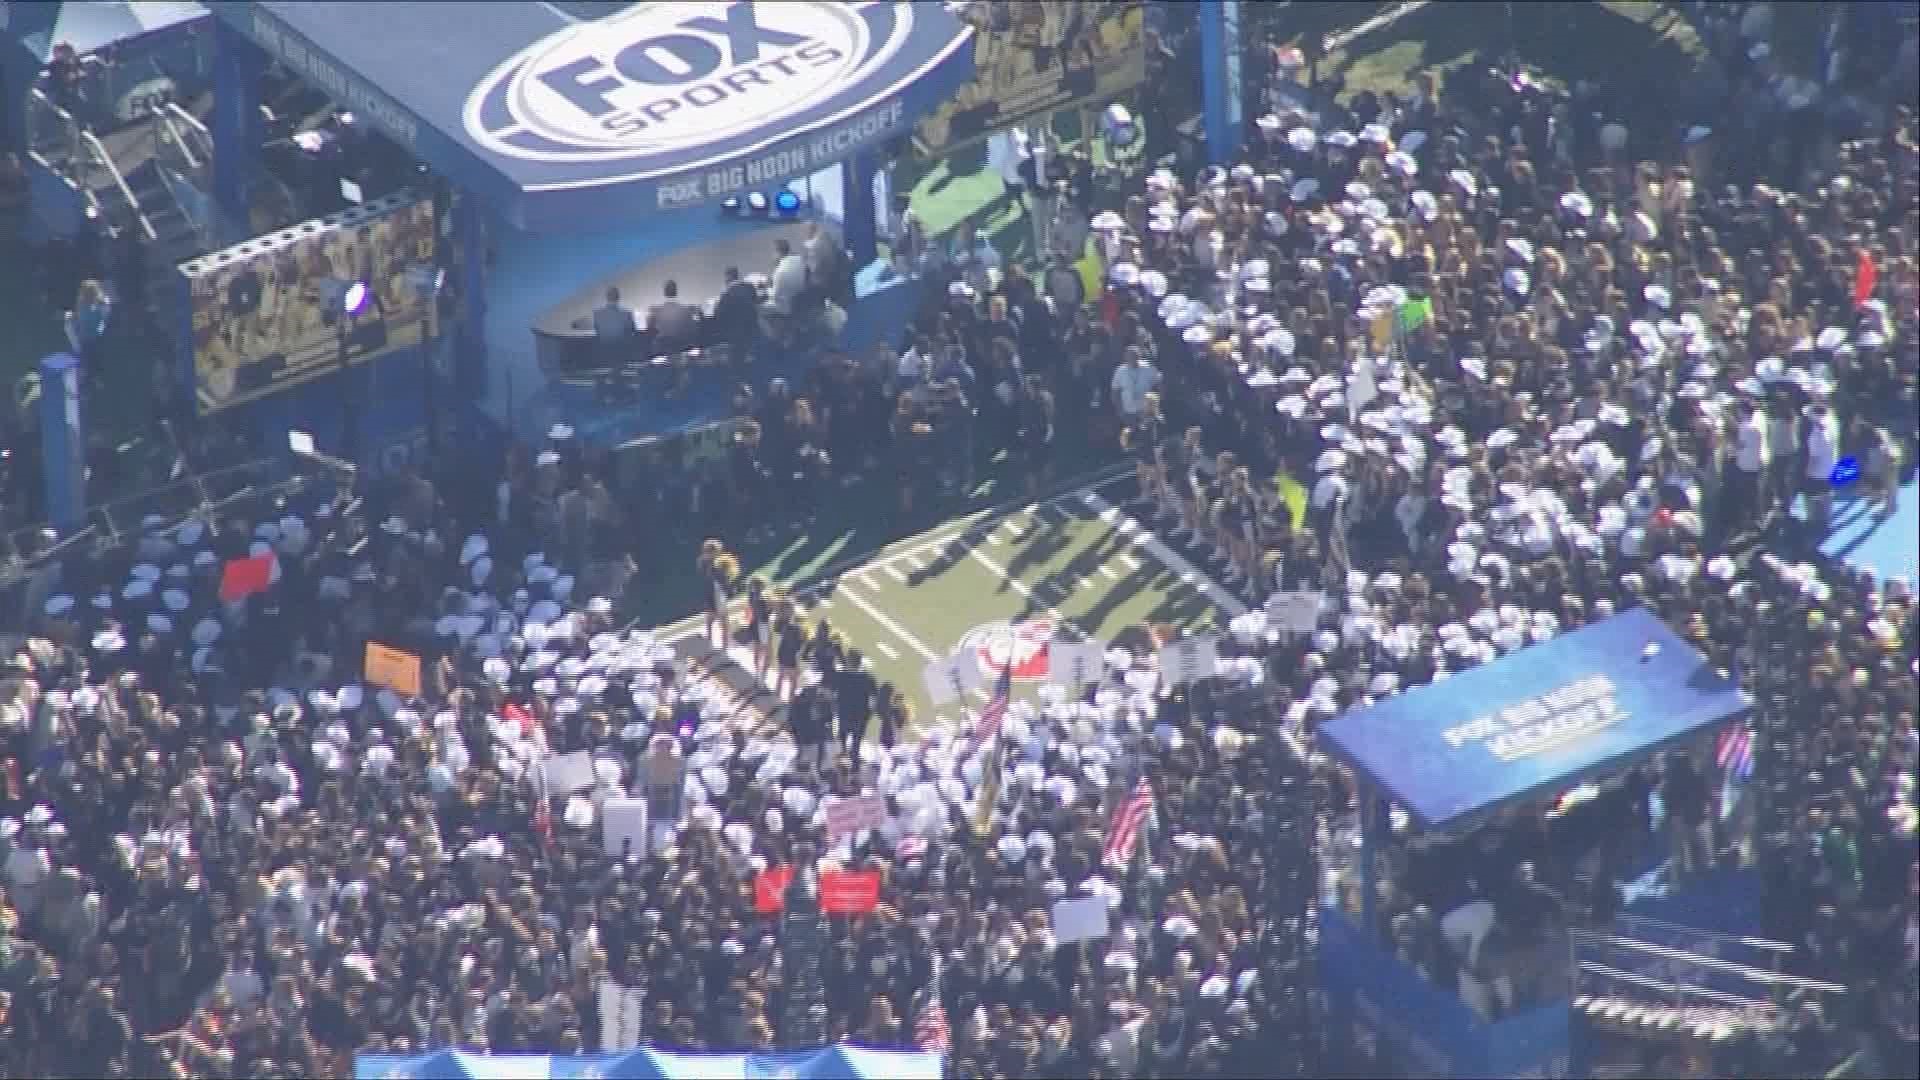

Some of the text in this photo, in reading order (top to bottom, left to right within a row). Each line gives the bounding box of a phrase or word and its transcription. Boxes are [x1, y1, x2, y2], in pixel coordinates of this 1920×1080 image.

[536, 2, 812, 117] FOX
[602, 40, 843, 136] SPORTS
[656, 101, 904, 207] FOX BIG NOON KICKOFF
